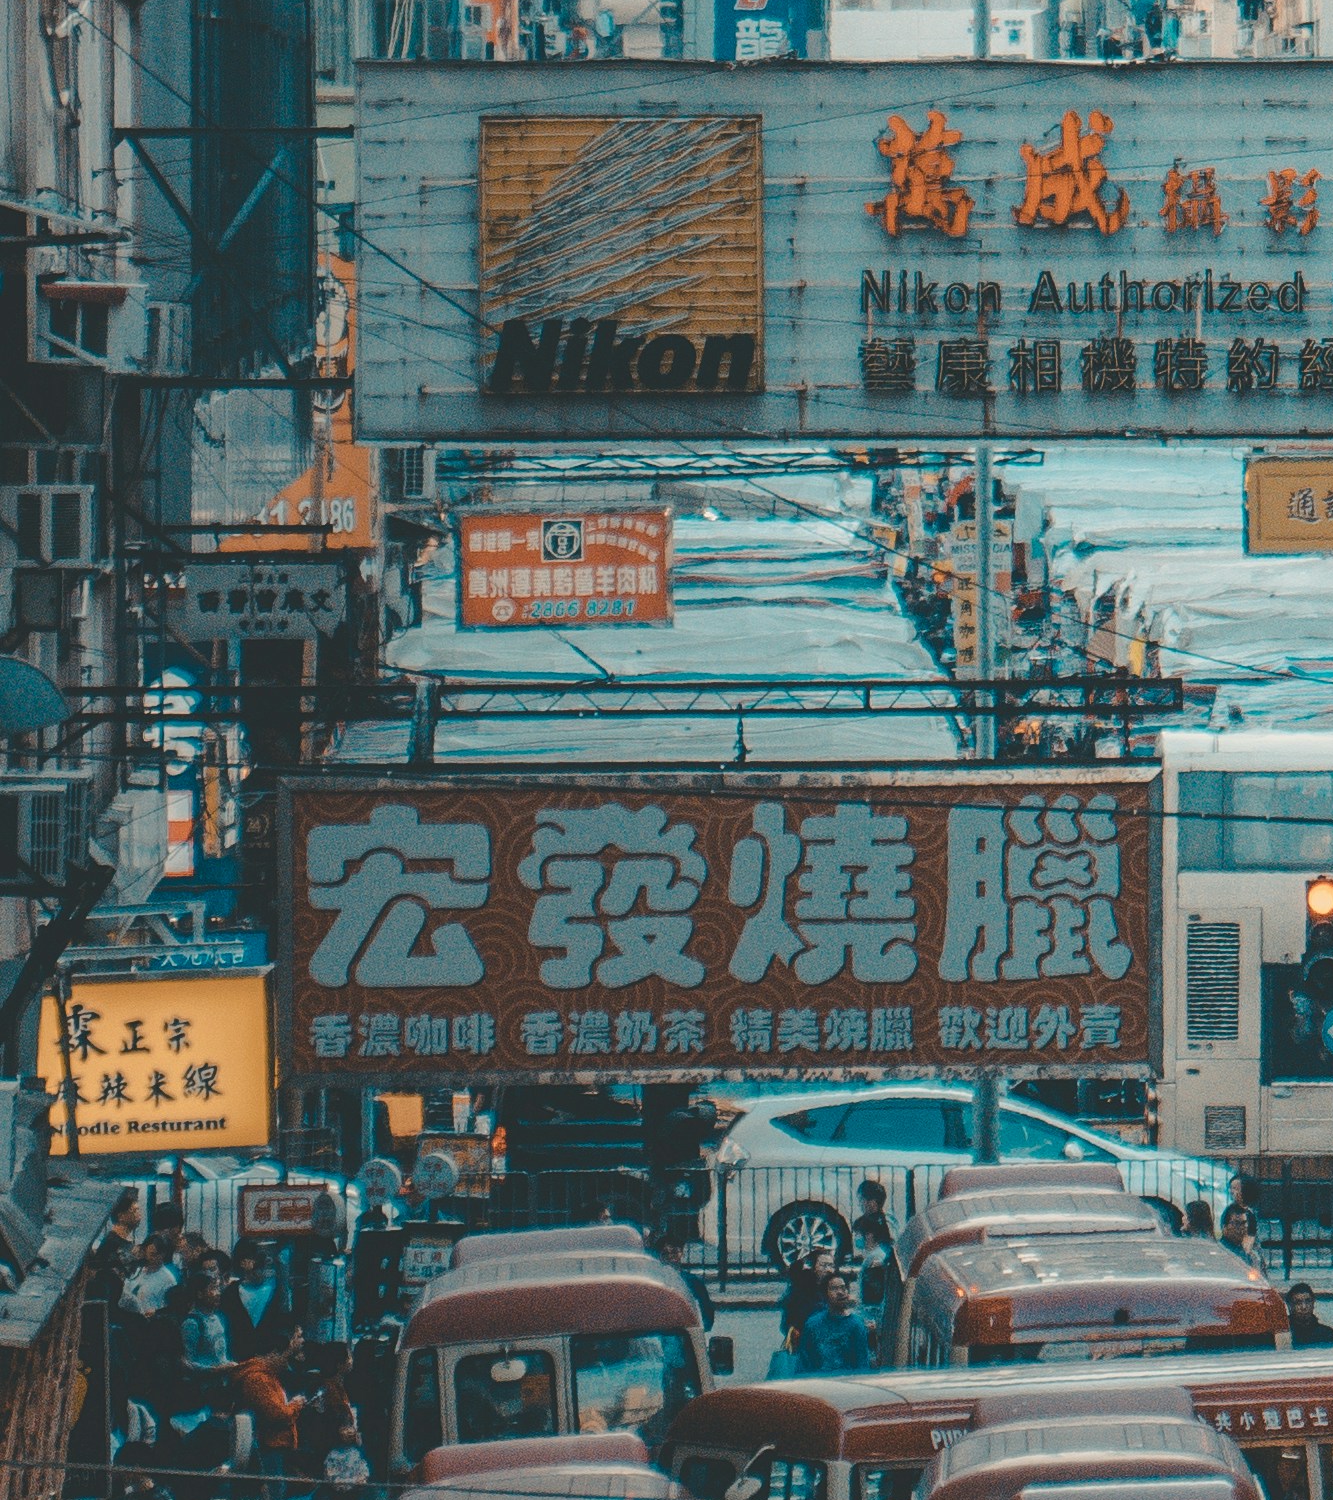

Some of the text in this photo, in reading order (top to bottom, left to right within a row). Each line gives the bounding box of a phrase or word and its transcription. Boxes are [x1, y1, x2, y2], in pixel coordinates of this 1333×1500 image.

[861, 268, 1000, 315] Nikon
[1028, 268, 1306, 314] Authorized
[488, 317, 755, 393] Nikon
[309, 1009, 497, 1058] 香濃咖啡
[519, 1009, 706, 1055] 香濃奶茶
[938, 1005, 1123, 1051] 歡迎外賣
[51, 1116, 228, 1140] Nodle Resturant
